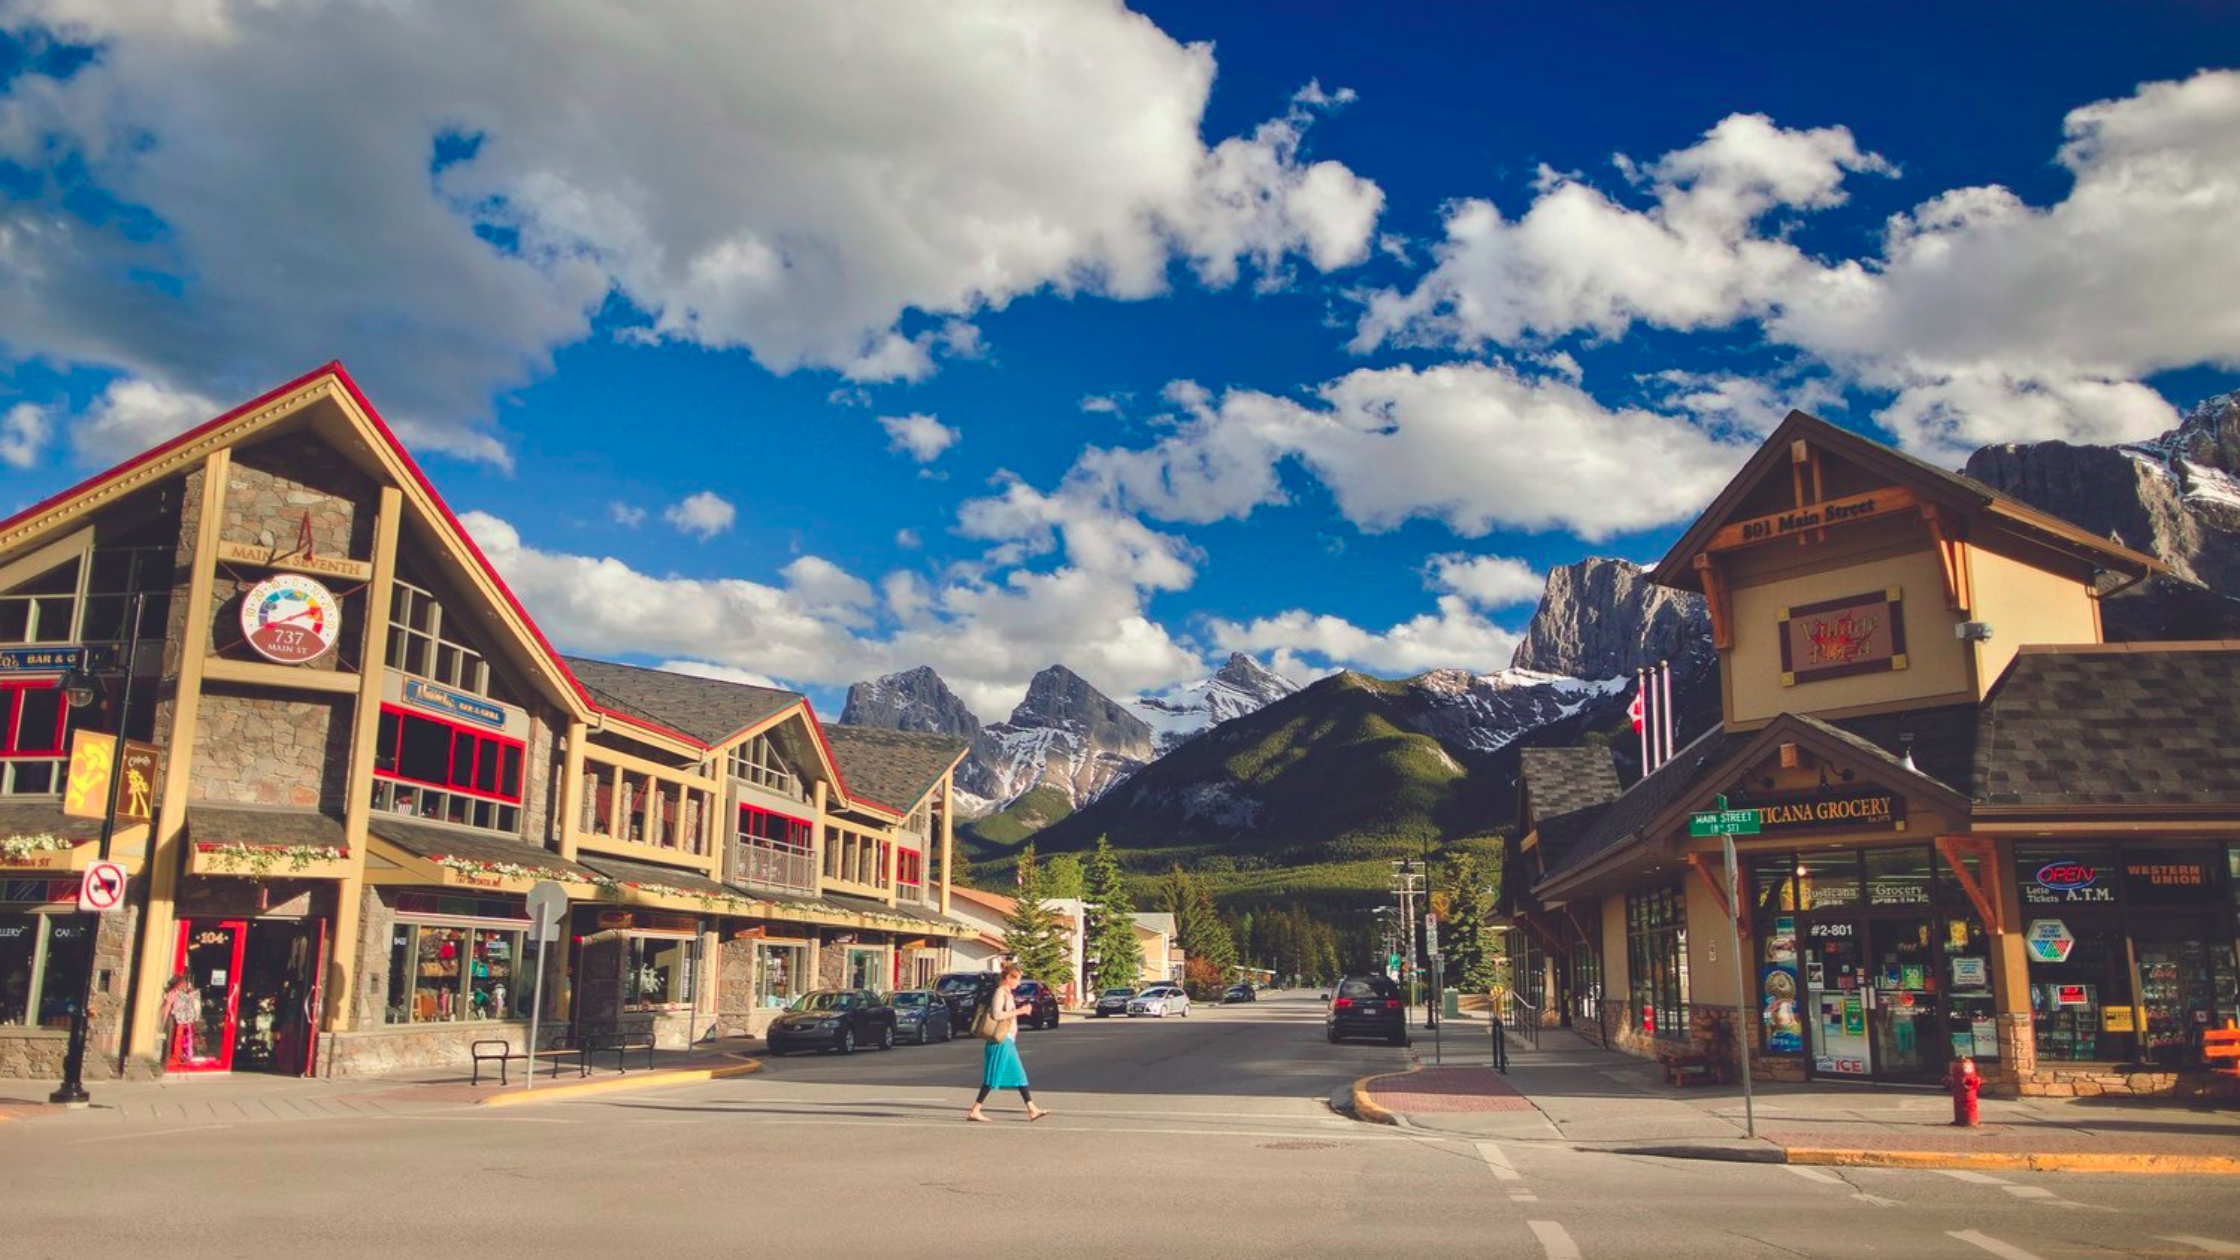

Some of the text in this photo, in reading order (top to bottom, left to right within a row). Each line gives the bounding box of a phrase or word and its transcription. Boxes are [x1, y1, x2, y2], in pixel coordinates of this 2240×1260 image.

[1743, 499, 1875, 539] 801 Main Street
[231, 546, 271, 561] MAIN
[292, 555, 360, 575] SEVENTH
[274, 629, 304, 645] 737
[267, 643, 308, 655] MAIN ST
[27, 654, 51, 664] BAR
[55, 654, 63, 663] &
[1760, 796, 1891, 824] TICANA GROCERY
[1695, 811, 1752, 824] MAIN STREET
[2039, 866, 2095, 882] OPEN
[2127, 865, 2200, 876] WESTERN
[2151, 875, 2201, 885] UNION
[1876, 884, 1923, 897] Grocery
[2026, 886, 2114, 901] Lotto A.T.M.
[2027, 894, 2059, 903] Tickets
[1811, 924, 1853, 937] #2-801
[201, 932, 224, 944] 104
[1835, 1060, 1863, 1074] ICE
